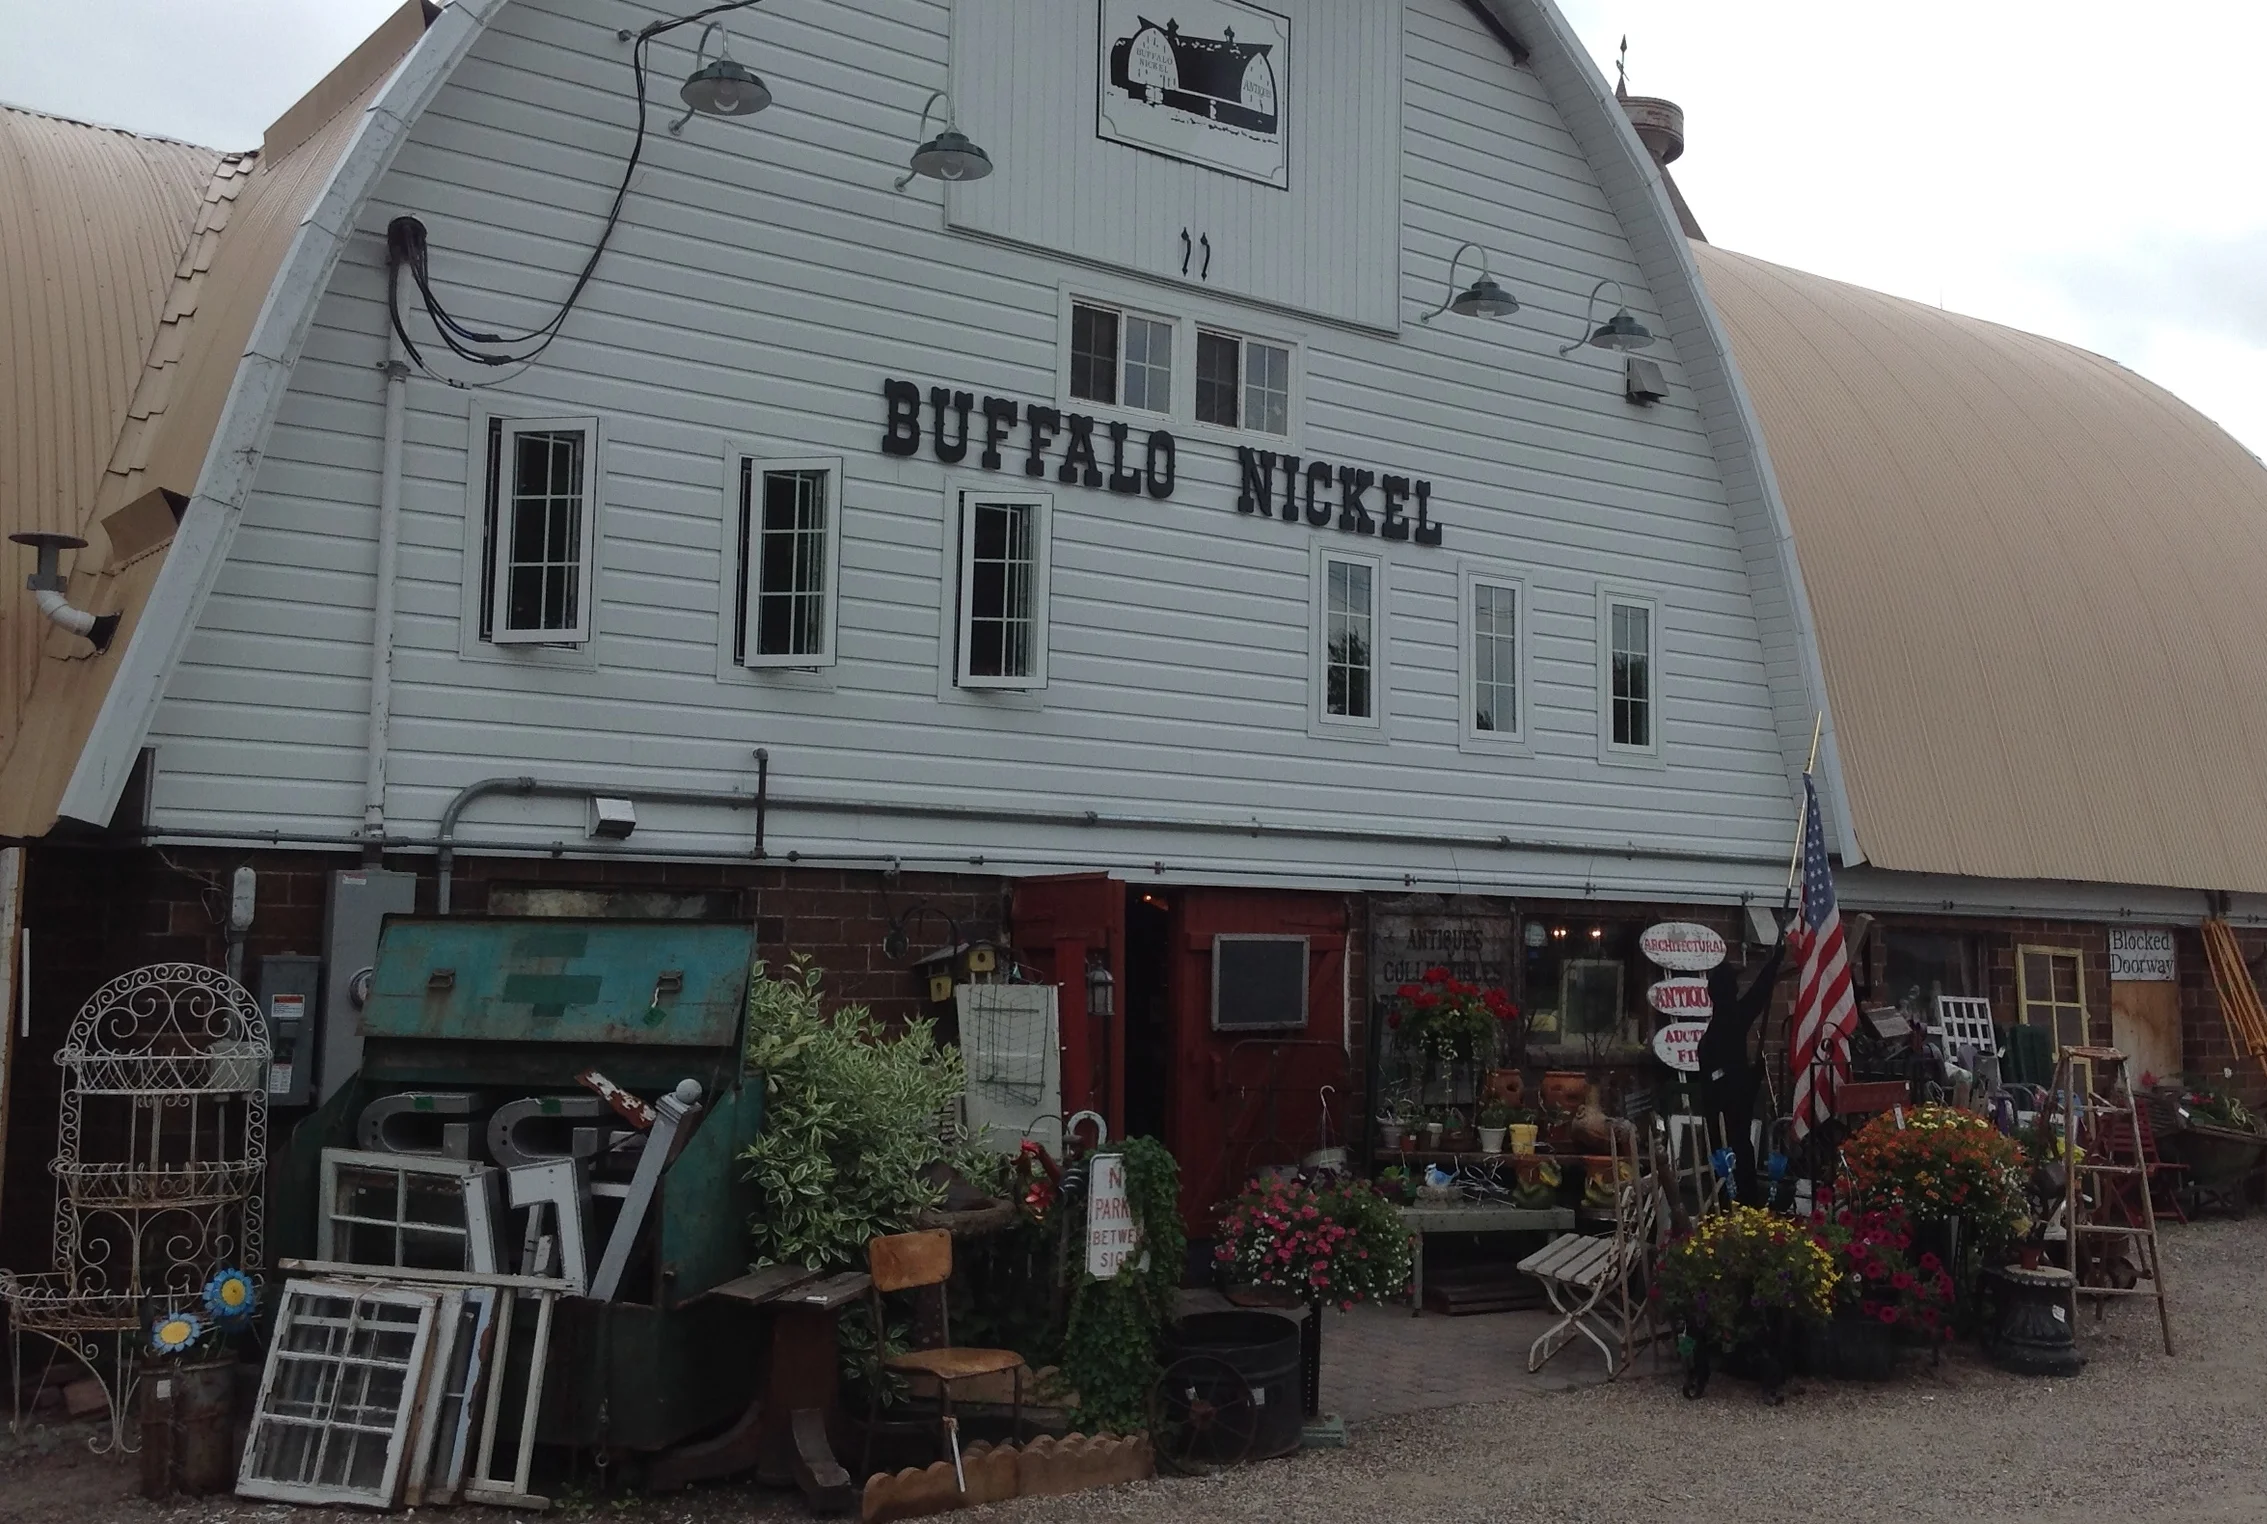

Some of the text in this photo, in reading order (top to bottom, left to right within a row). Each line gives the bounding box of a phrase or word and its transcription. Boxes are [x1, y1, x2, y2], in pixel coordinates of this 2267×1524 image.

[1136, 48, 1174, 65] BUFFALO
[1139, 58, 1168, 74] NICKEL
[882, 377, 1442, 545] BUFFALO NICKEL
[1406, 928, 1483, 960] ANTIQUES
[1644, 938, 1726, 953] ARCHITECTURAL
[2112, 930, 2170, 950] Blocked
[2110, 953, 2174, 978] Doorway
[1655, 986, 1713, 1008] ANTIQU
[1677, 1049, 1699, 1063] FI
[1108, 1166, 1122, 1189] N
[1095, 1198, 1131, 1219] PARK
[1092, 1228, 1140, 1246] BETWE
[1100, 1251, 1124, 1268] SIG
